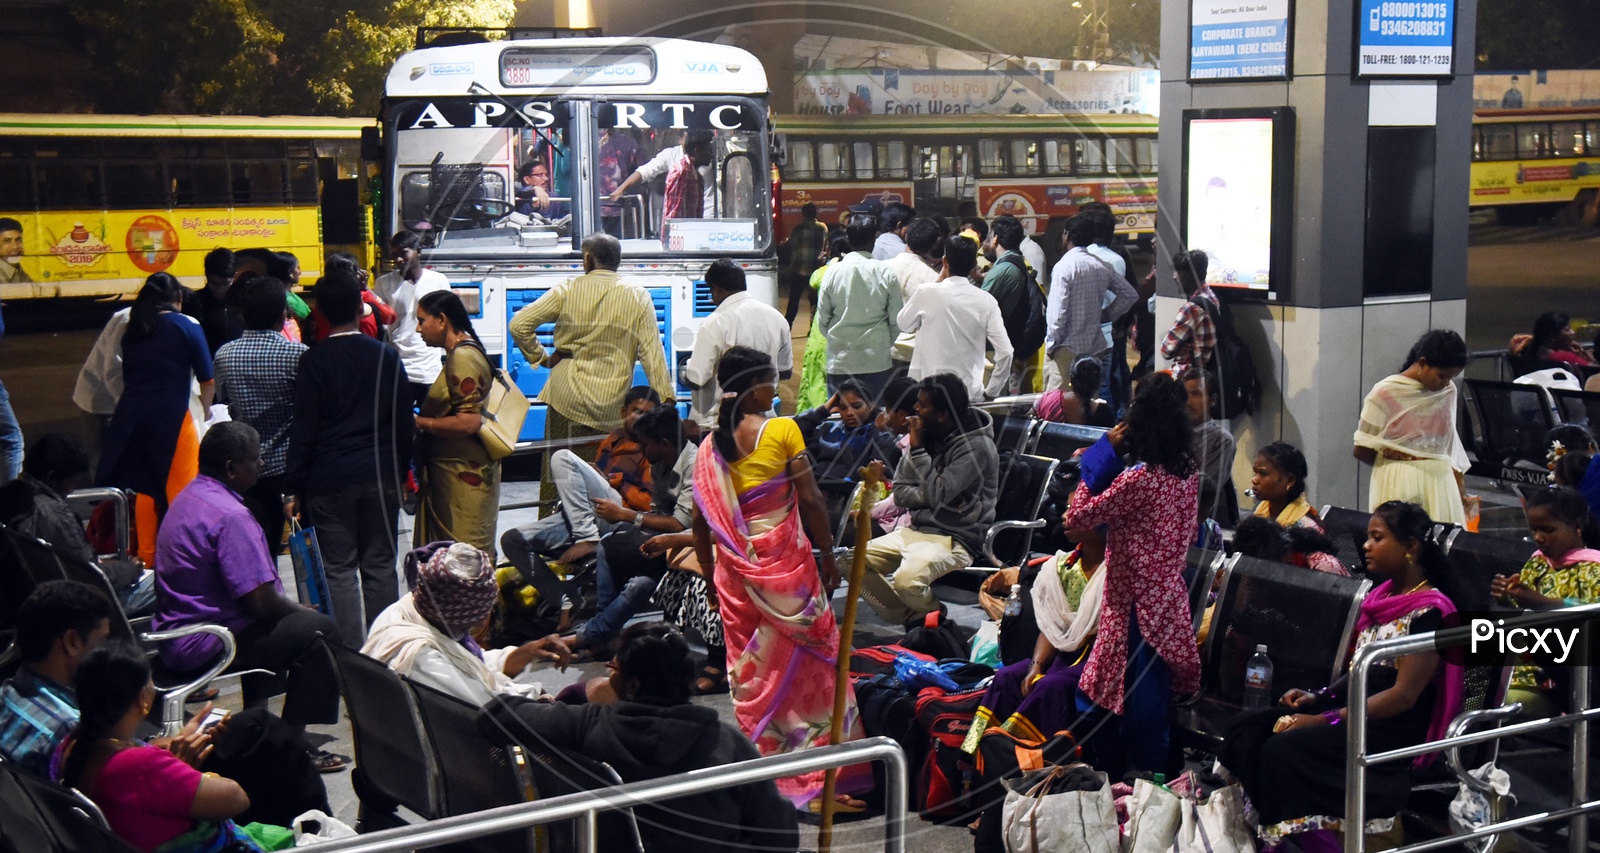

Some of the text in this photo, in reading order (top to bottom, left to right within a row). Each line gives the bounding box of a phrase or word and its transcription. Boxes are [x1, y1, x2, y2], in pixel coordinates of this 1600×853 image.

[1382, 2, 1446, 18] 8800013015
[1202, 26, 1277, 41] CORPORATE BRANCH
[1381, 20, 1446, 36] 9346208831
[1363, 55, 1450, 64] TOLL-FREE: 1800-121-1239
[686, 63, 719, 72] VJA
[507, 68, 530, 83] 3880
[819, 85, 841, 98] Day
[912, 82, 989, 98] Day by Day
[885, 100, 970, 114] Foot Wear
[1045, 97, 1109, 110] Accessories
